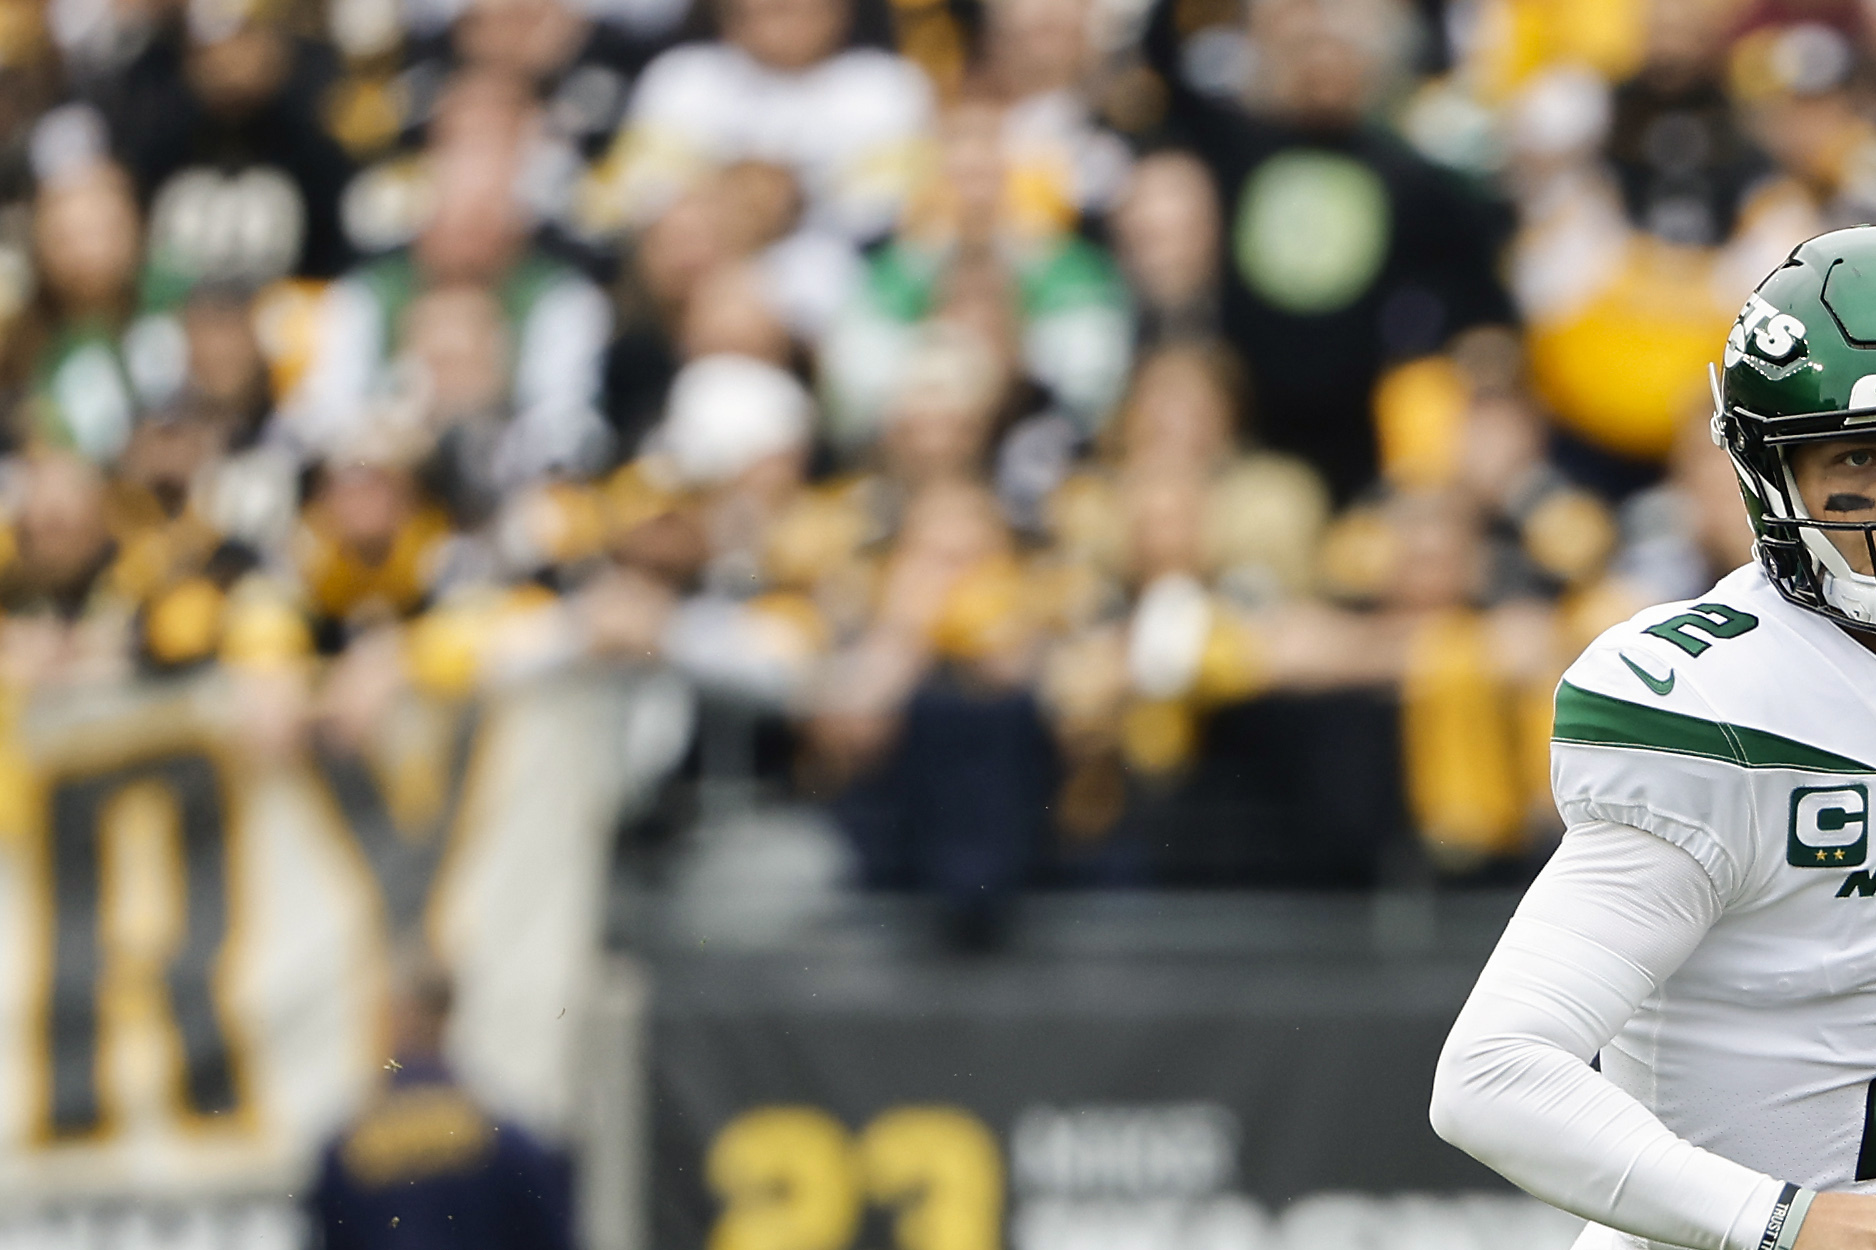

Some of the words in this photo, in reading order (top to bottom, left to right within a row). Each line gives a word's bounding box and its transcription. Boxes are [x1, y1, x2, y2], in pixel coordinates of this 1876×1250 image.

[1640, 603, 1759, 658] 2
[1796, 790, 1864, 847] C
[1764, 1203, 1789, 1239] TRUST
